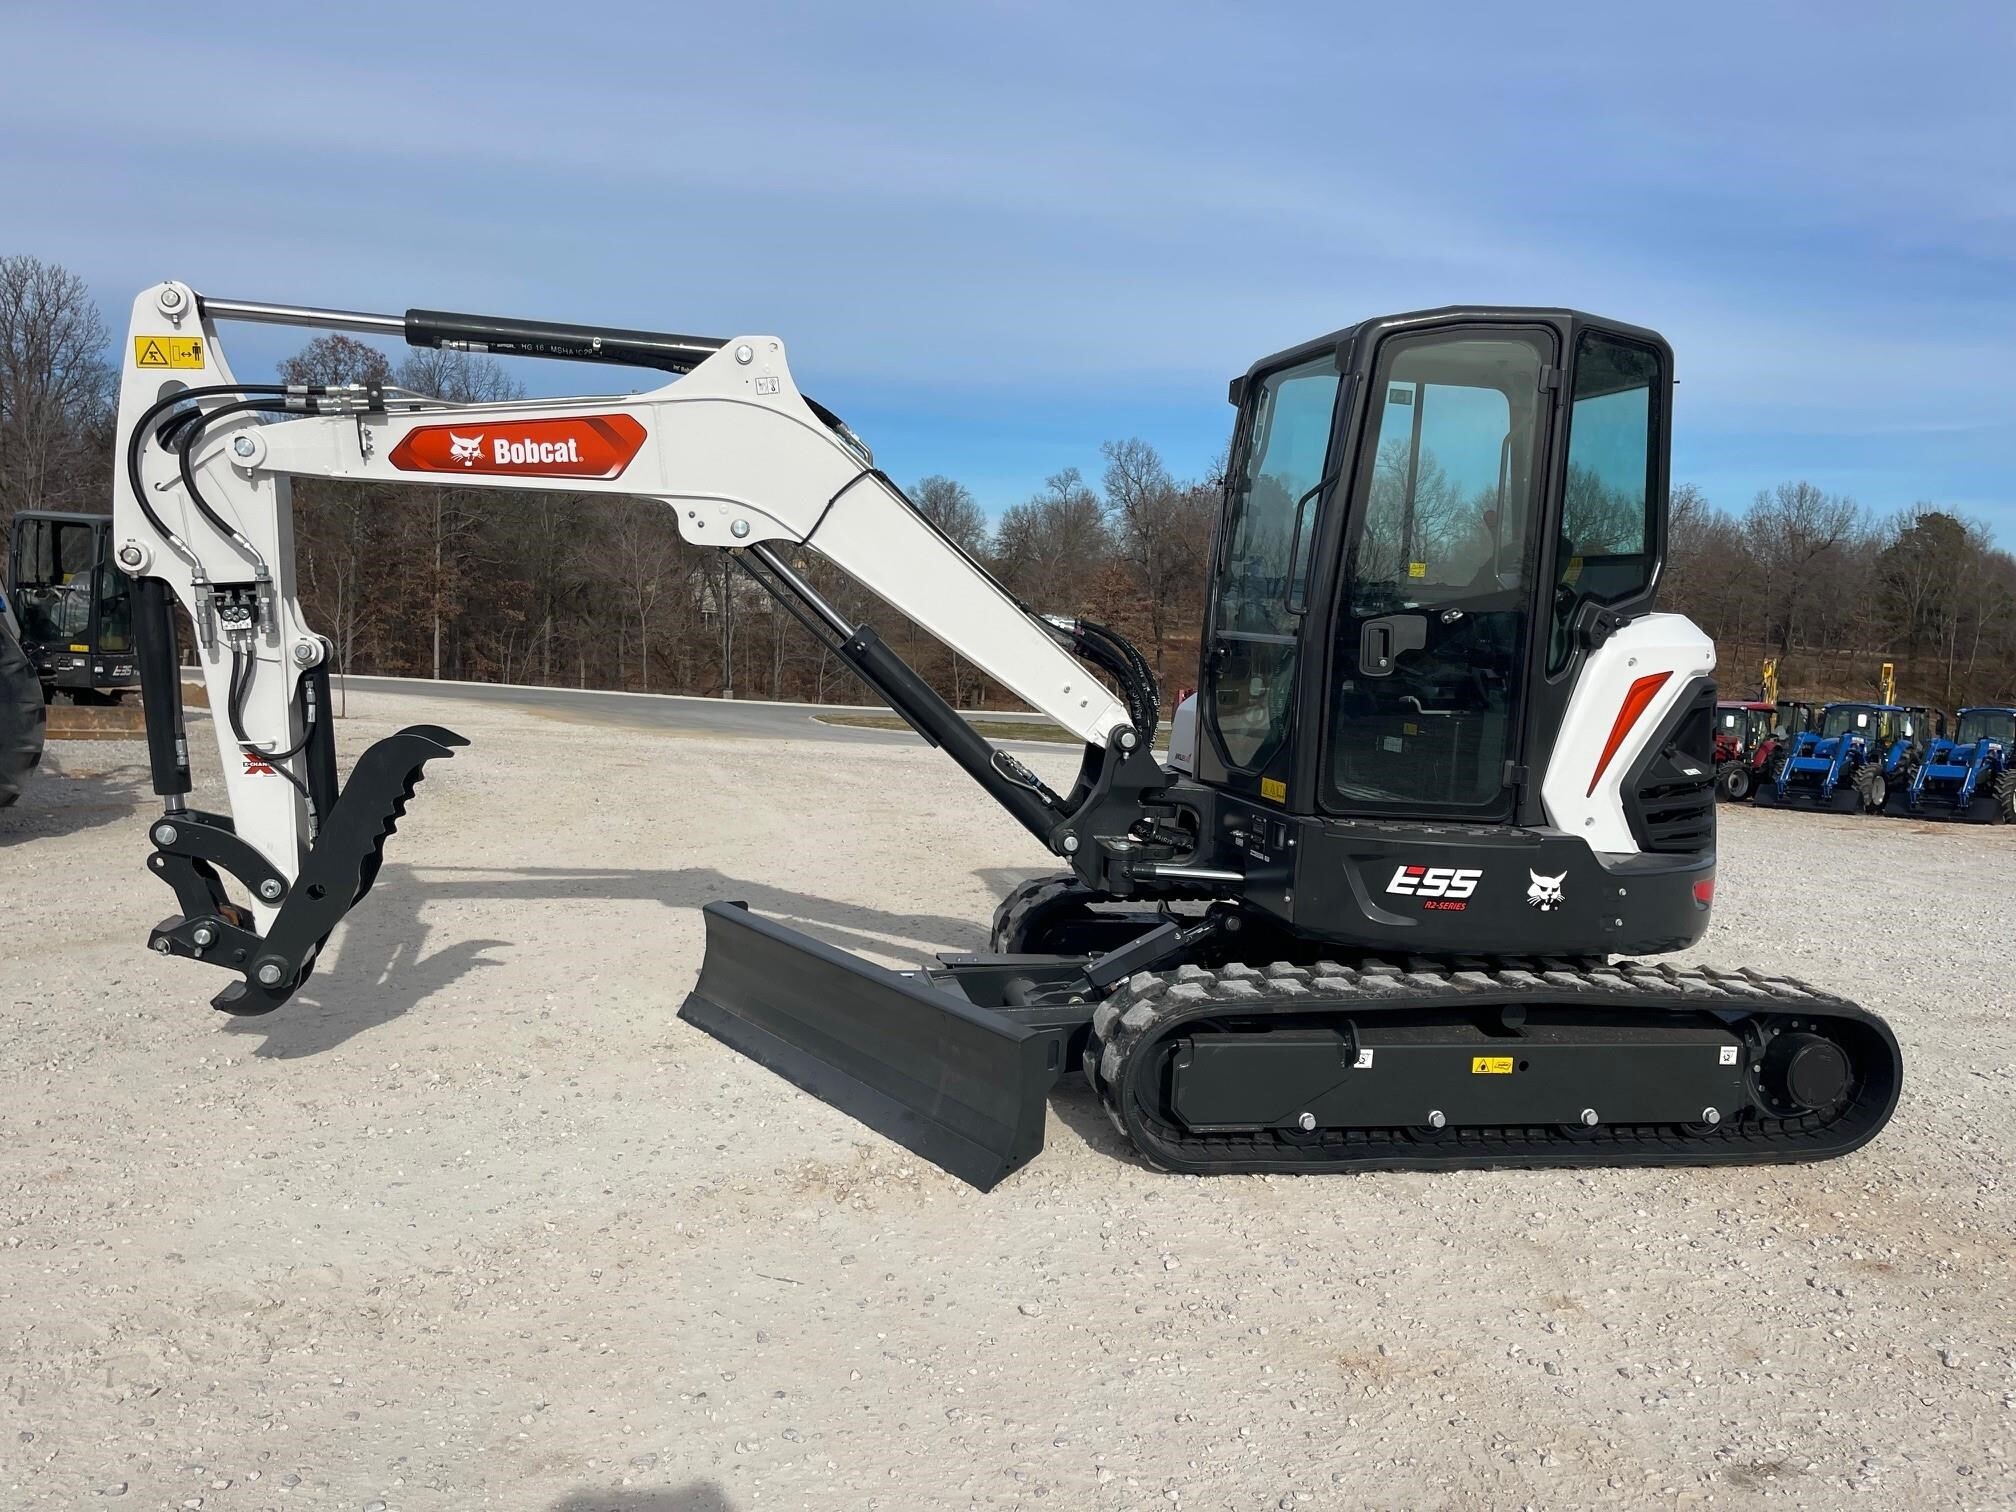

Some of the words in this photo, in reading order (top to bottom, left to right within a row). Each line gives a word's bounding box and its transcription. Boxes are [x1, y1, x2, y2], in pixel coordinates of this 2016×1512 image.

[493, 438, 579, 465] Bobcat
[1385, 865, 1484, 899] E55
[1424, 901, 1467, 911] R2-SERIES
